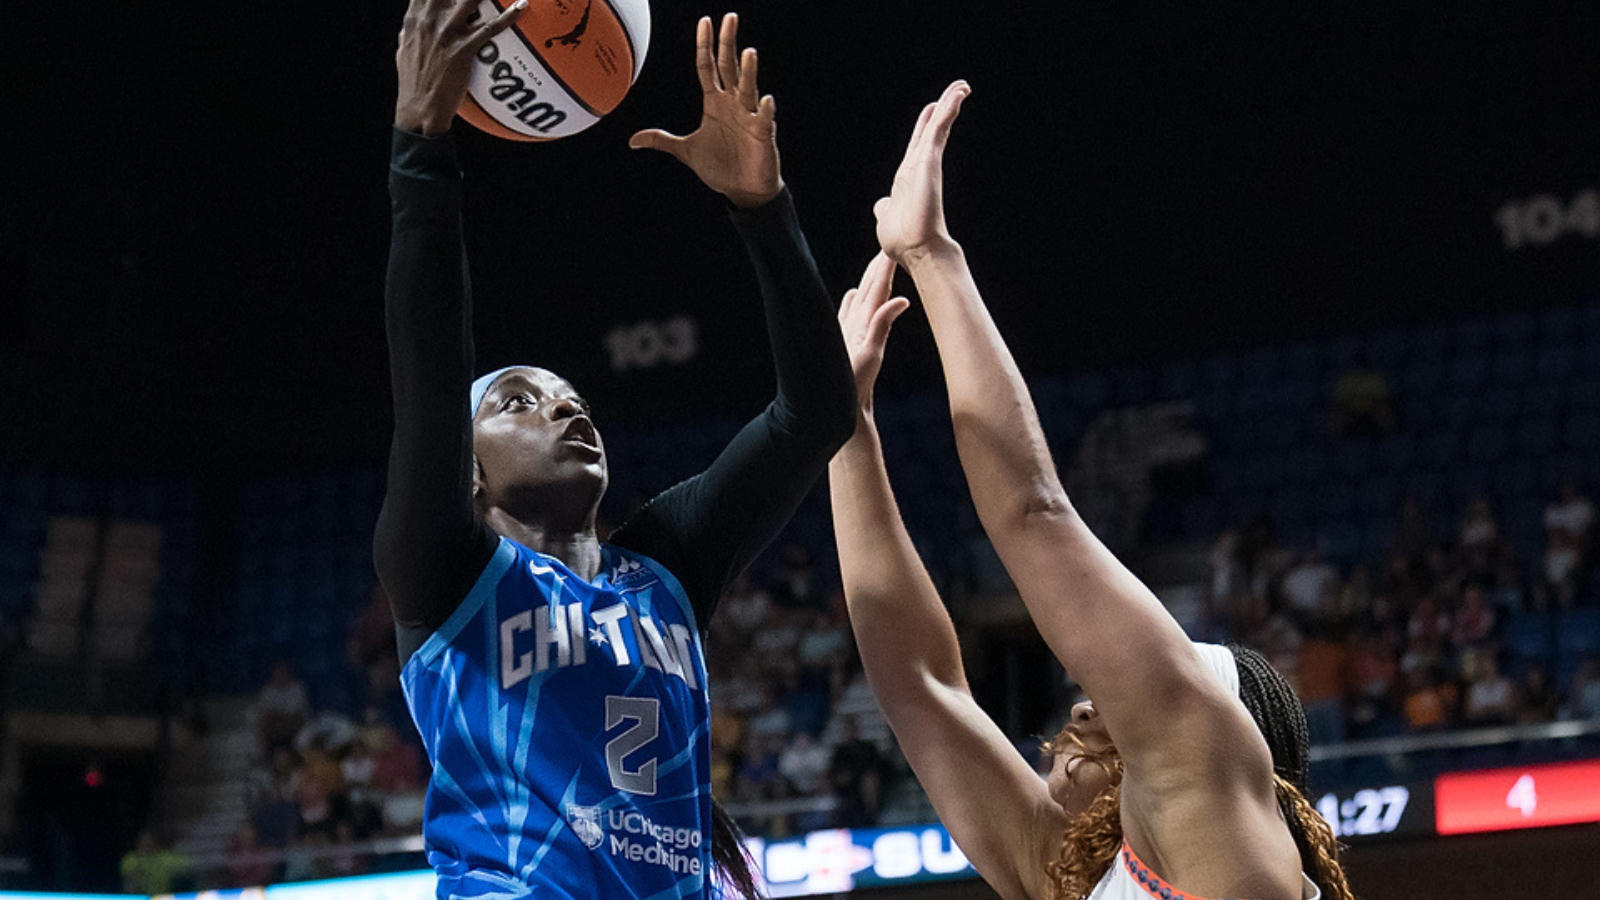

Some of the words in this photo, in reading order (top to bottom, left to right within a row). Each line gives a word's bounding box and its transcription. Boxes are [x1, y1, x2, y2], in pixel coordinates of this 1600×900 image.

[605, 319, 698, 368] 103
[605, 695, 660, 796] 2
[1506, 774, 1537, 817] 4
